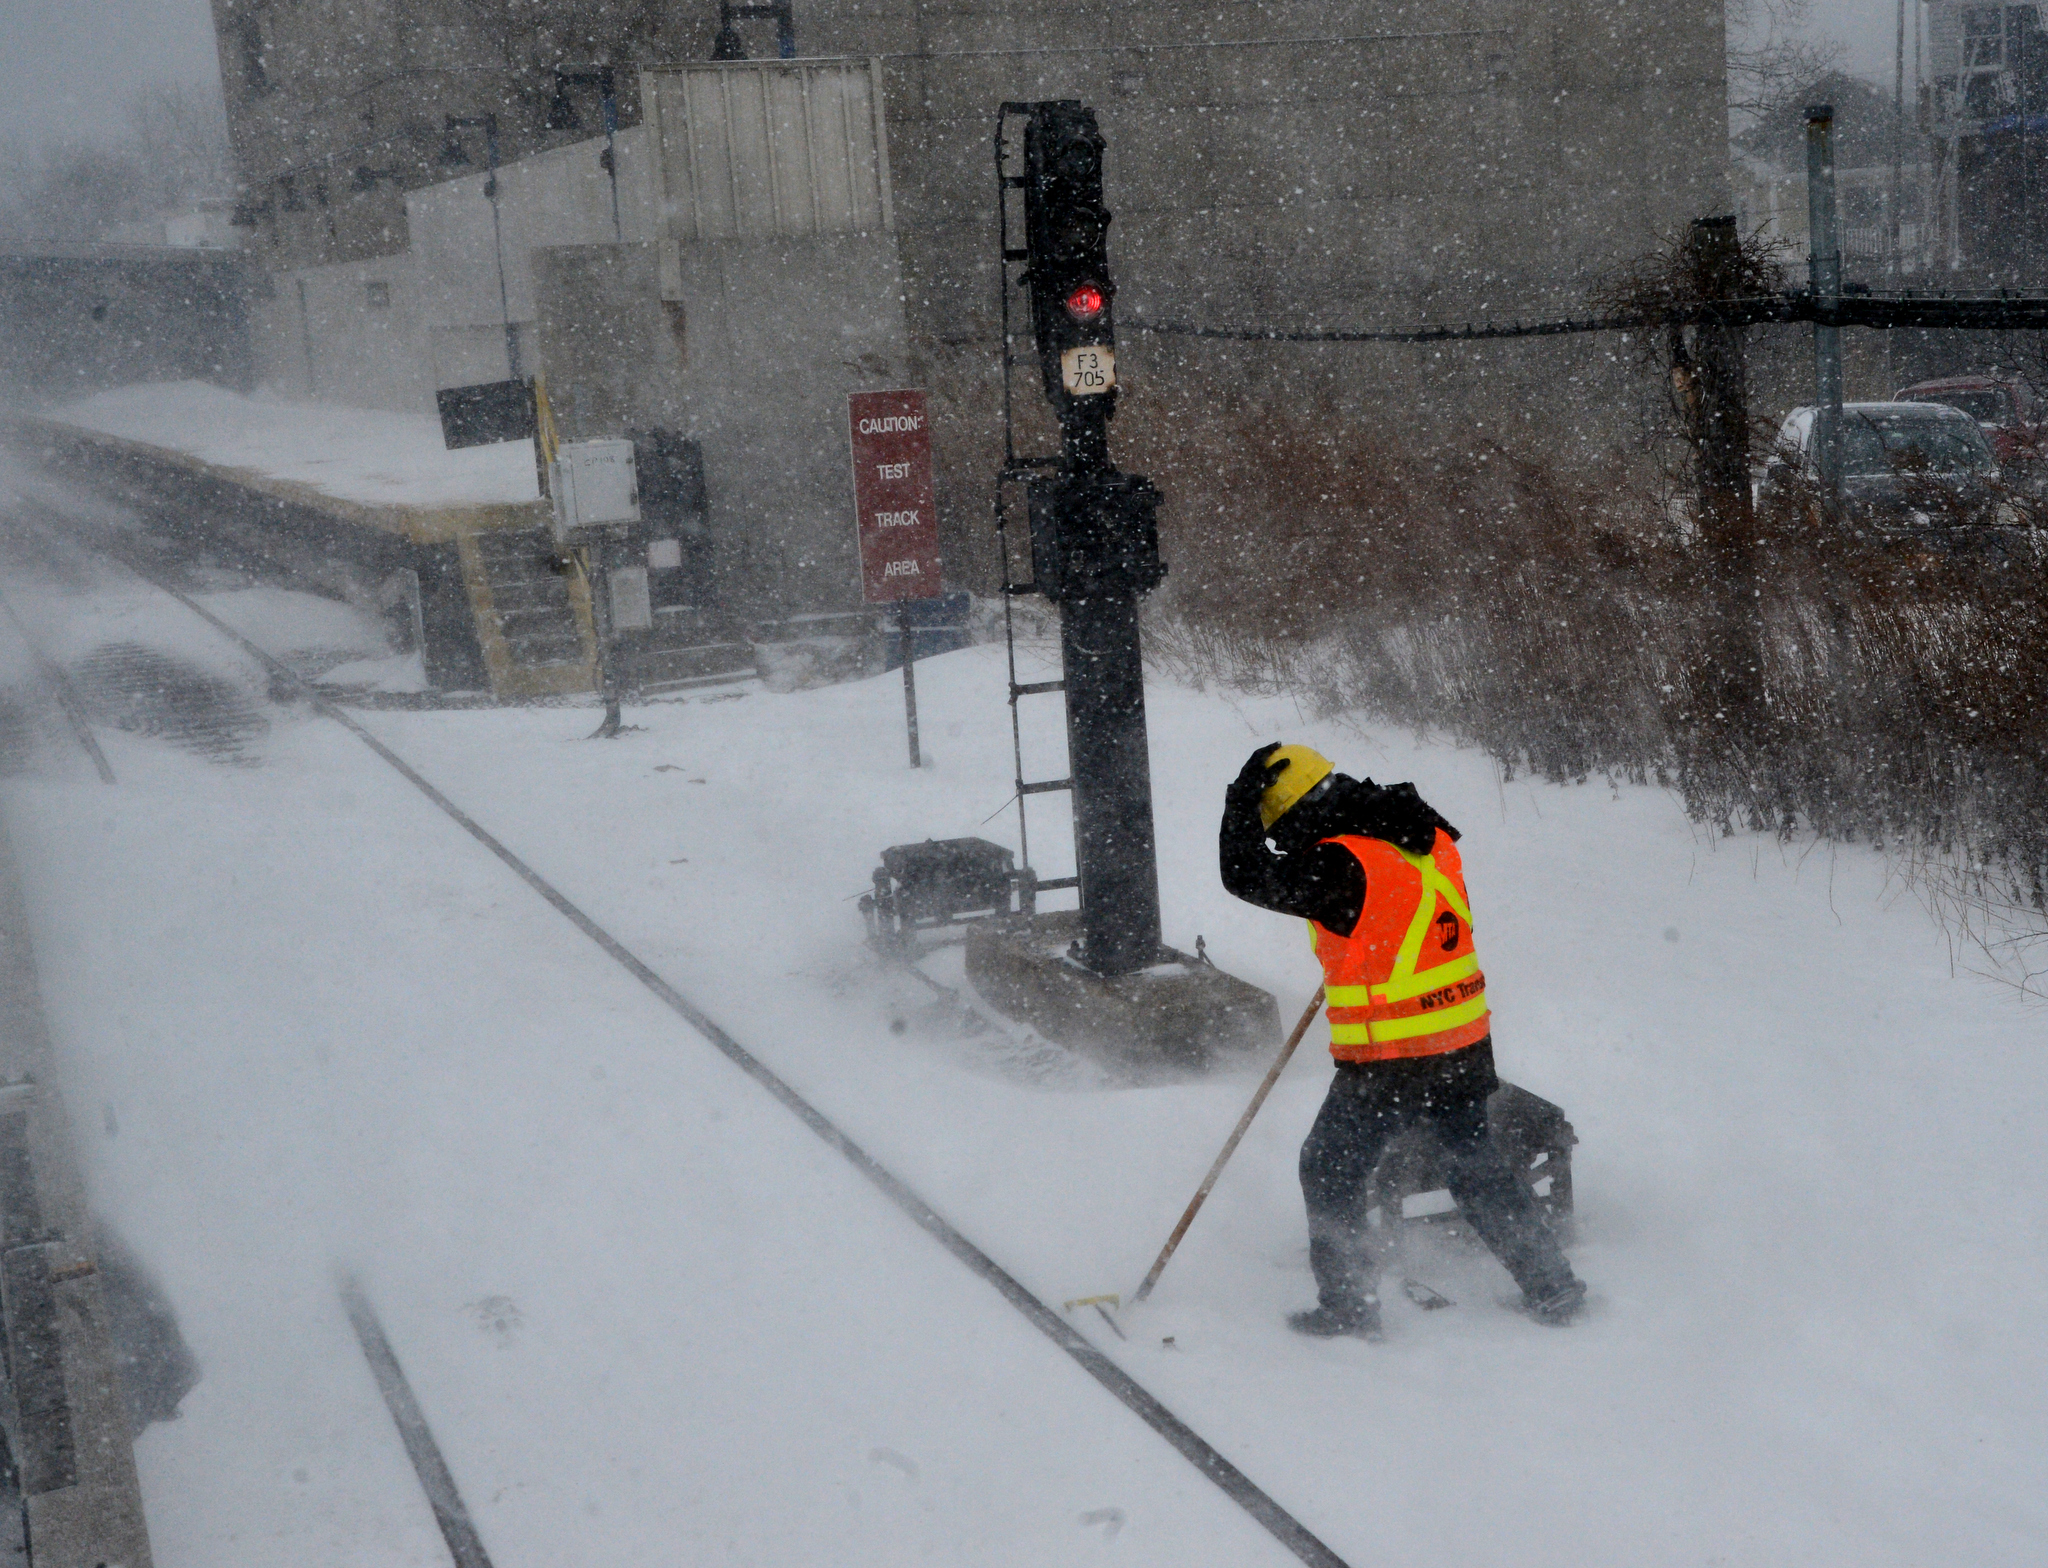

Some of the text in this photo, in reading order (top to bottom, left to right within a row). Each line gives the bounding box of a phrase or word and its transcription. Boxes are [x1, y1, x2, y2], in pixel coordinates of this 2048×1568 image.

[1077, 353, 1098, 370] F3
[1073, 370, 1105, 388] 705
[876, 463, 911, 480] TEST
[875, 510, 921, 528] TRACK
[884, 560, 920, 577] AREA
[1420, 988, 1456, 1010] NYC
